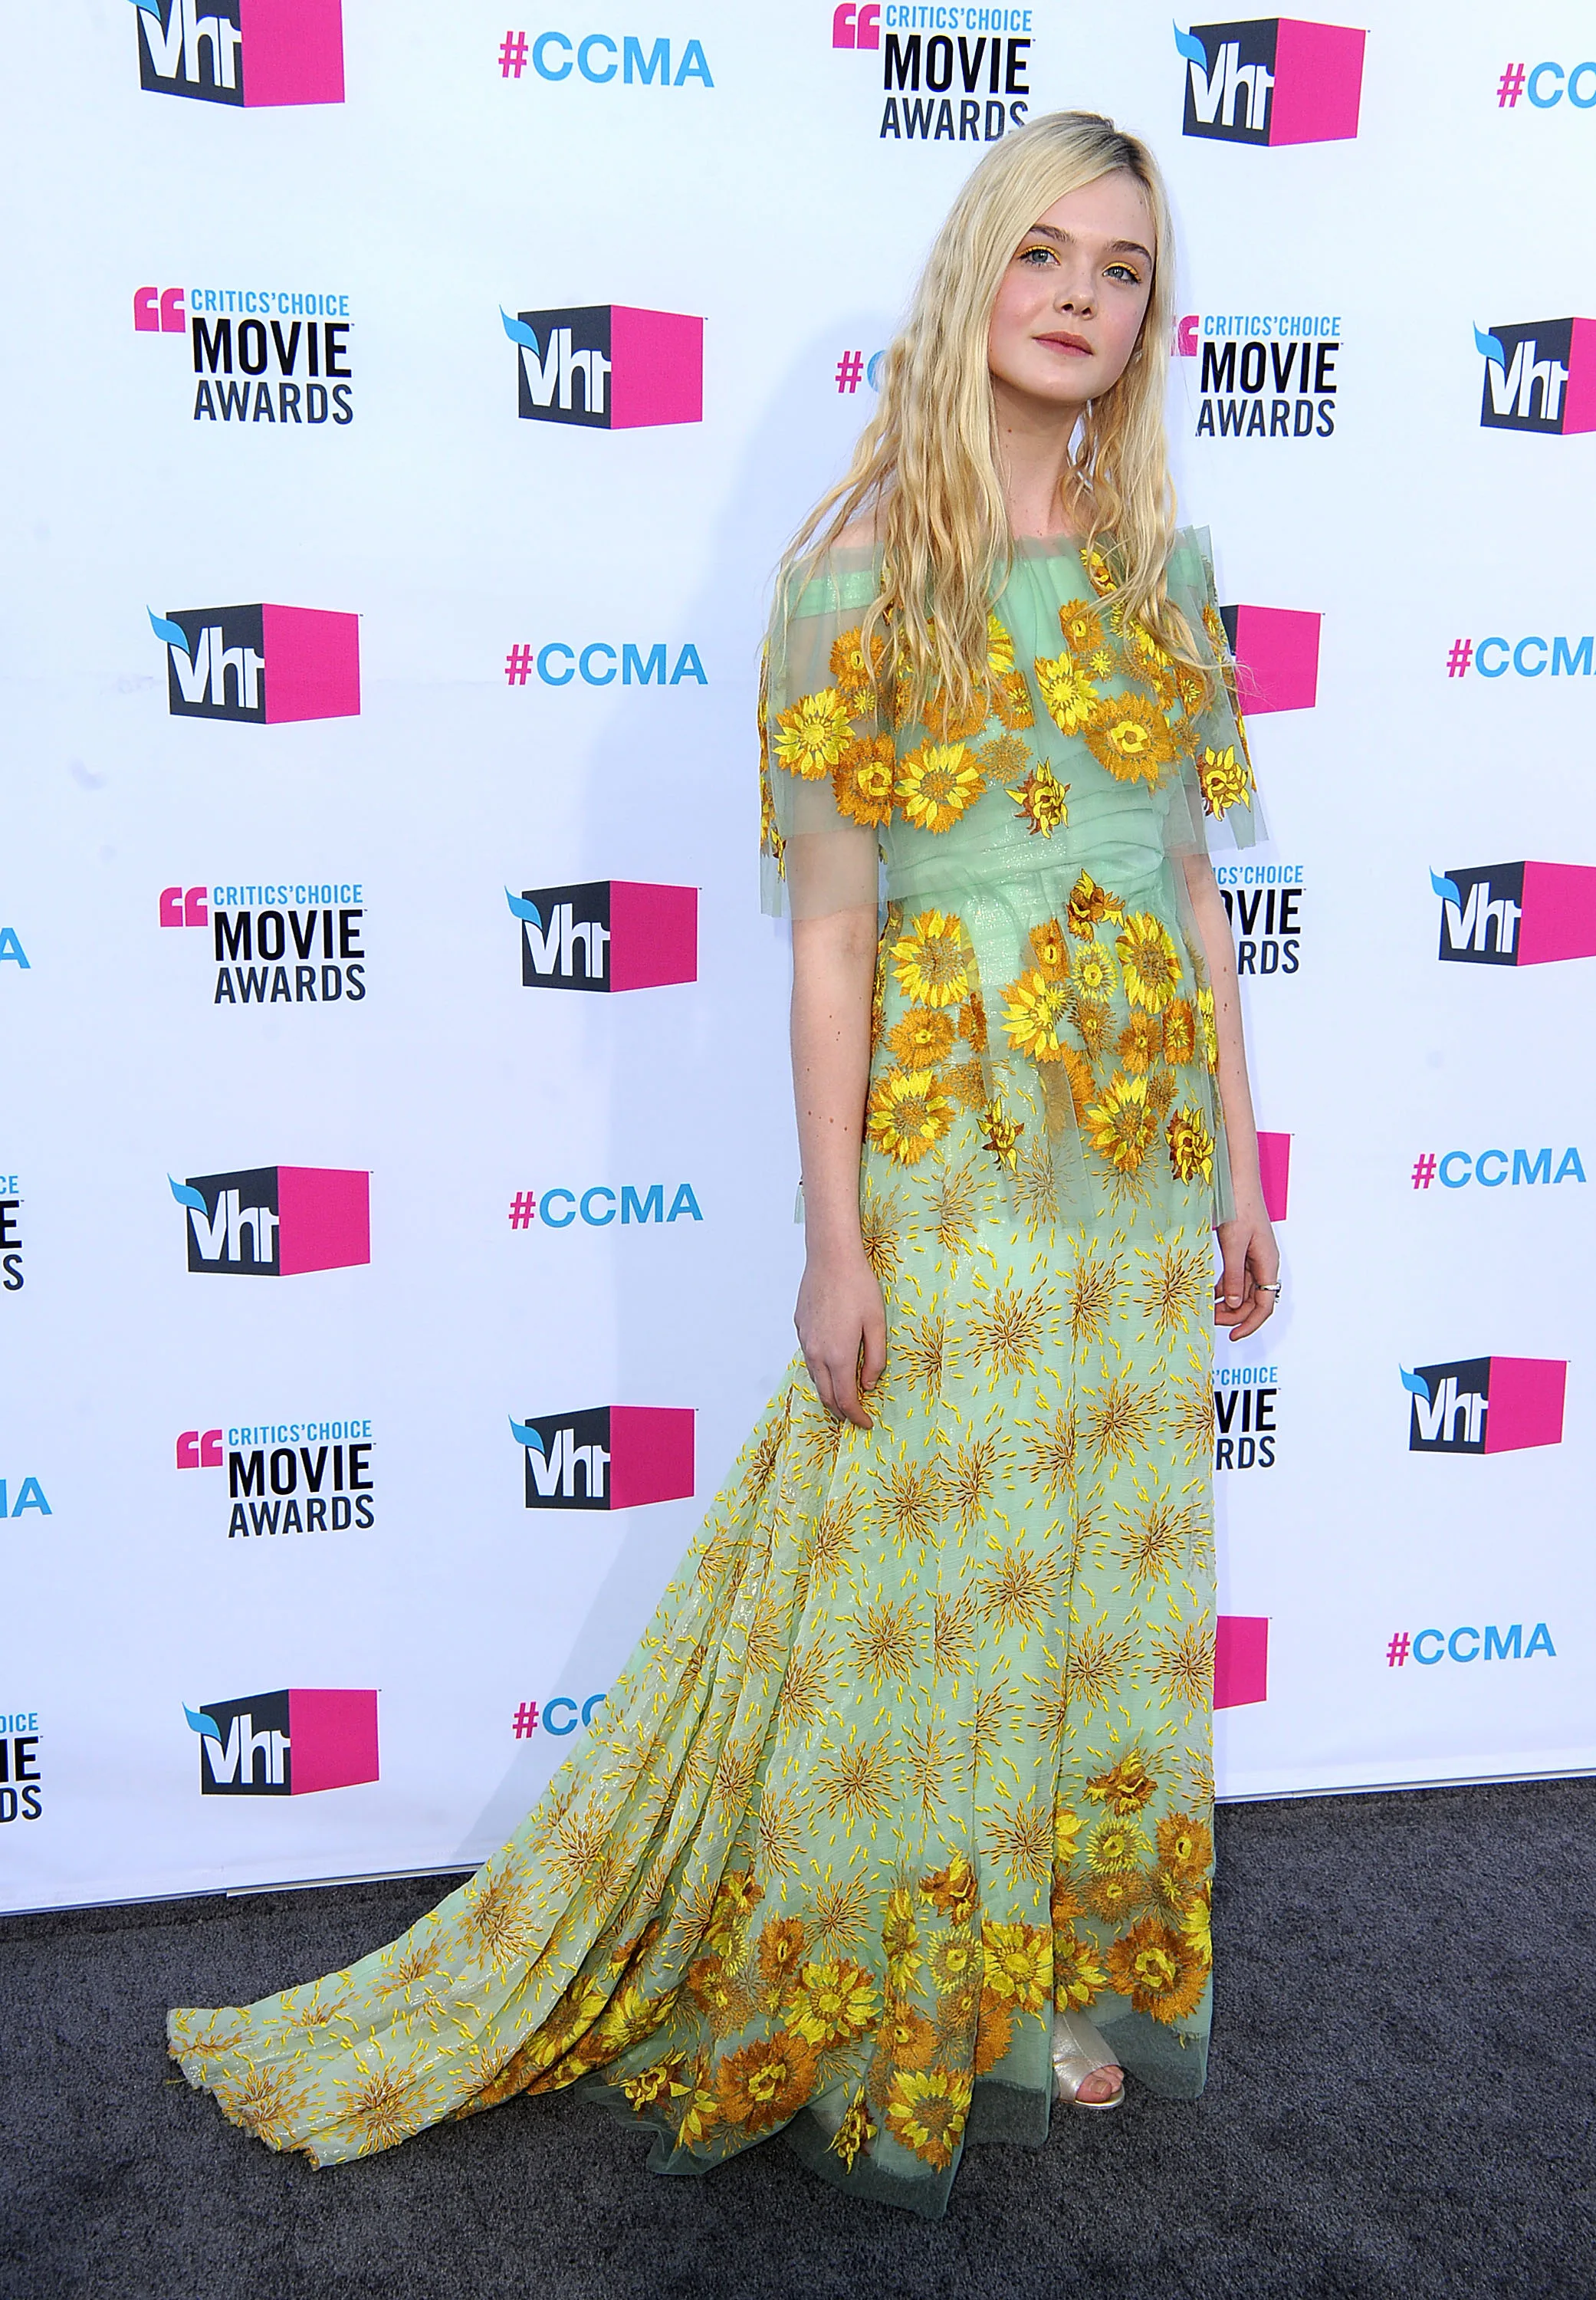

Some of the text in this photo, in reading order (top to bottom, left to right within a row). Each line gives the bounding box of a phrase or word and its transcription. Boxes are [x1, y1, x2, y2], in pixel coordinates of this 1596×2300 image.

[498, 31, 714, 87] #CCMA
[885, 34, 1030, 94] MOVIE
[1497, 62, 1596, 108] #CC
[192, 317, 351, 377] MOVIE
[1201, 342, 1339, 393] MOVIE
[194, 380, 353, 424] AWARDS
[1198, 399, 1335, 436] AWARDS
[505, 642, 708, 686] #CCMA
[1447, 636, 1596, 678] #CCM
[215, 909, 364, 961] MOVIE
[1238, 940, 1299, 974] RDS
[215, 964, 365, 1004] AWARDS
[1412, 1147, 1586, 1188] #CCMA
[509, 1183, 703, 1229] #CCMA
[1214, 1388, 1276, 1433] VIE
[229, 1444, 373, 1500] MOVIE
[1217, 1436, 1275, 1470] RDS
[228, 1492, 373, 1538] AWARDS
[1387, 1622, 1556, 1667] #CCMA
